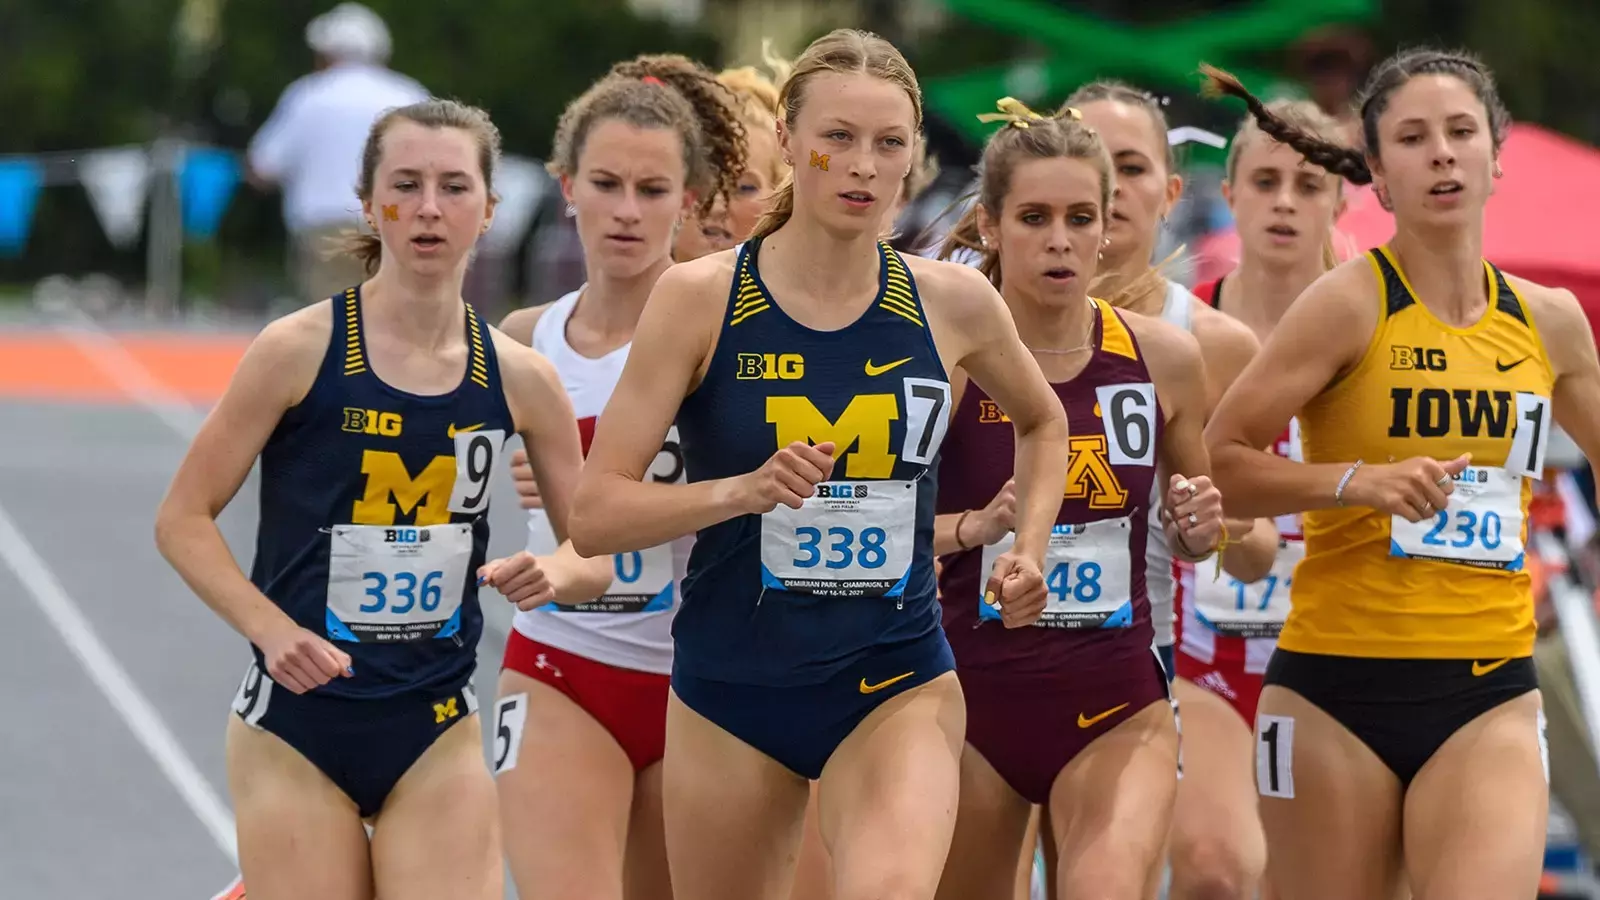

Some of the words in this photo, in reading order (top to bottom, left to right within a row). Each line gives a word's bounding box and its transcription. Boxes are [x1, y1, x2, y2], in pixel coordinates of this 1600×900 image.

[810, 149, 830, 171] M
[766, 393, 899, 479] M
[911, 384, 945, 458] 7
[1110, 389, 1150, 459] 6
[1388, 387, 1517, 438] IOW
[1524, 402, 1544, 472] 1
[352, 449, 457, 526] M
[462, 435, 493, 509] 9
[793, 526, 888, 569] 338
[1422, 509, 1502, 550] 230
[360, 571, 443, 614] 336
[1047, 562, 1102, 603] 48
[432, 697, 459, 724] M
[494, 700, 517, 772] 5
[1261, 721, 1279, 792] 1
